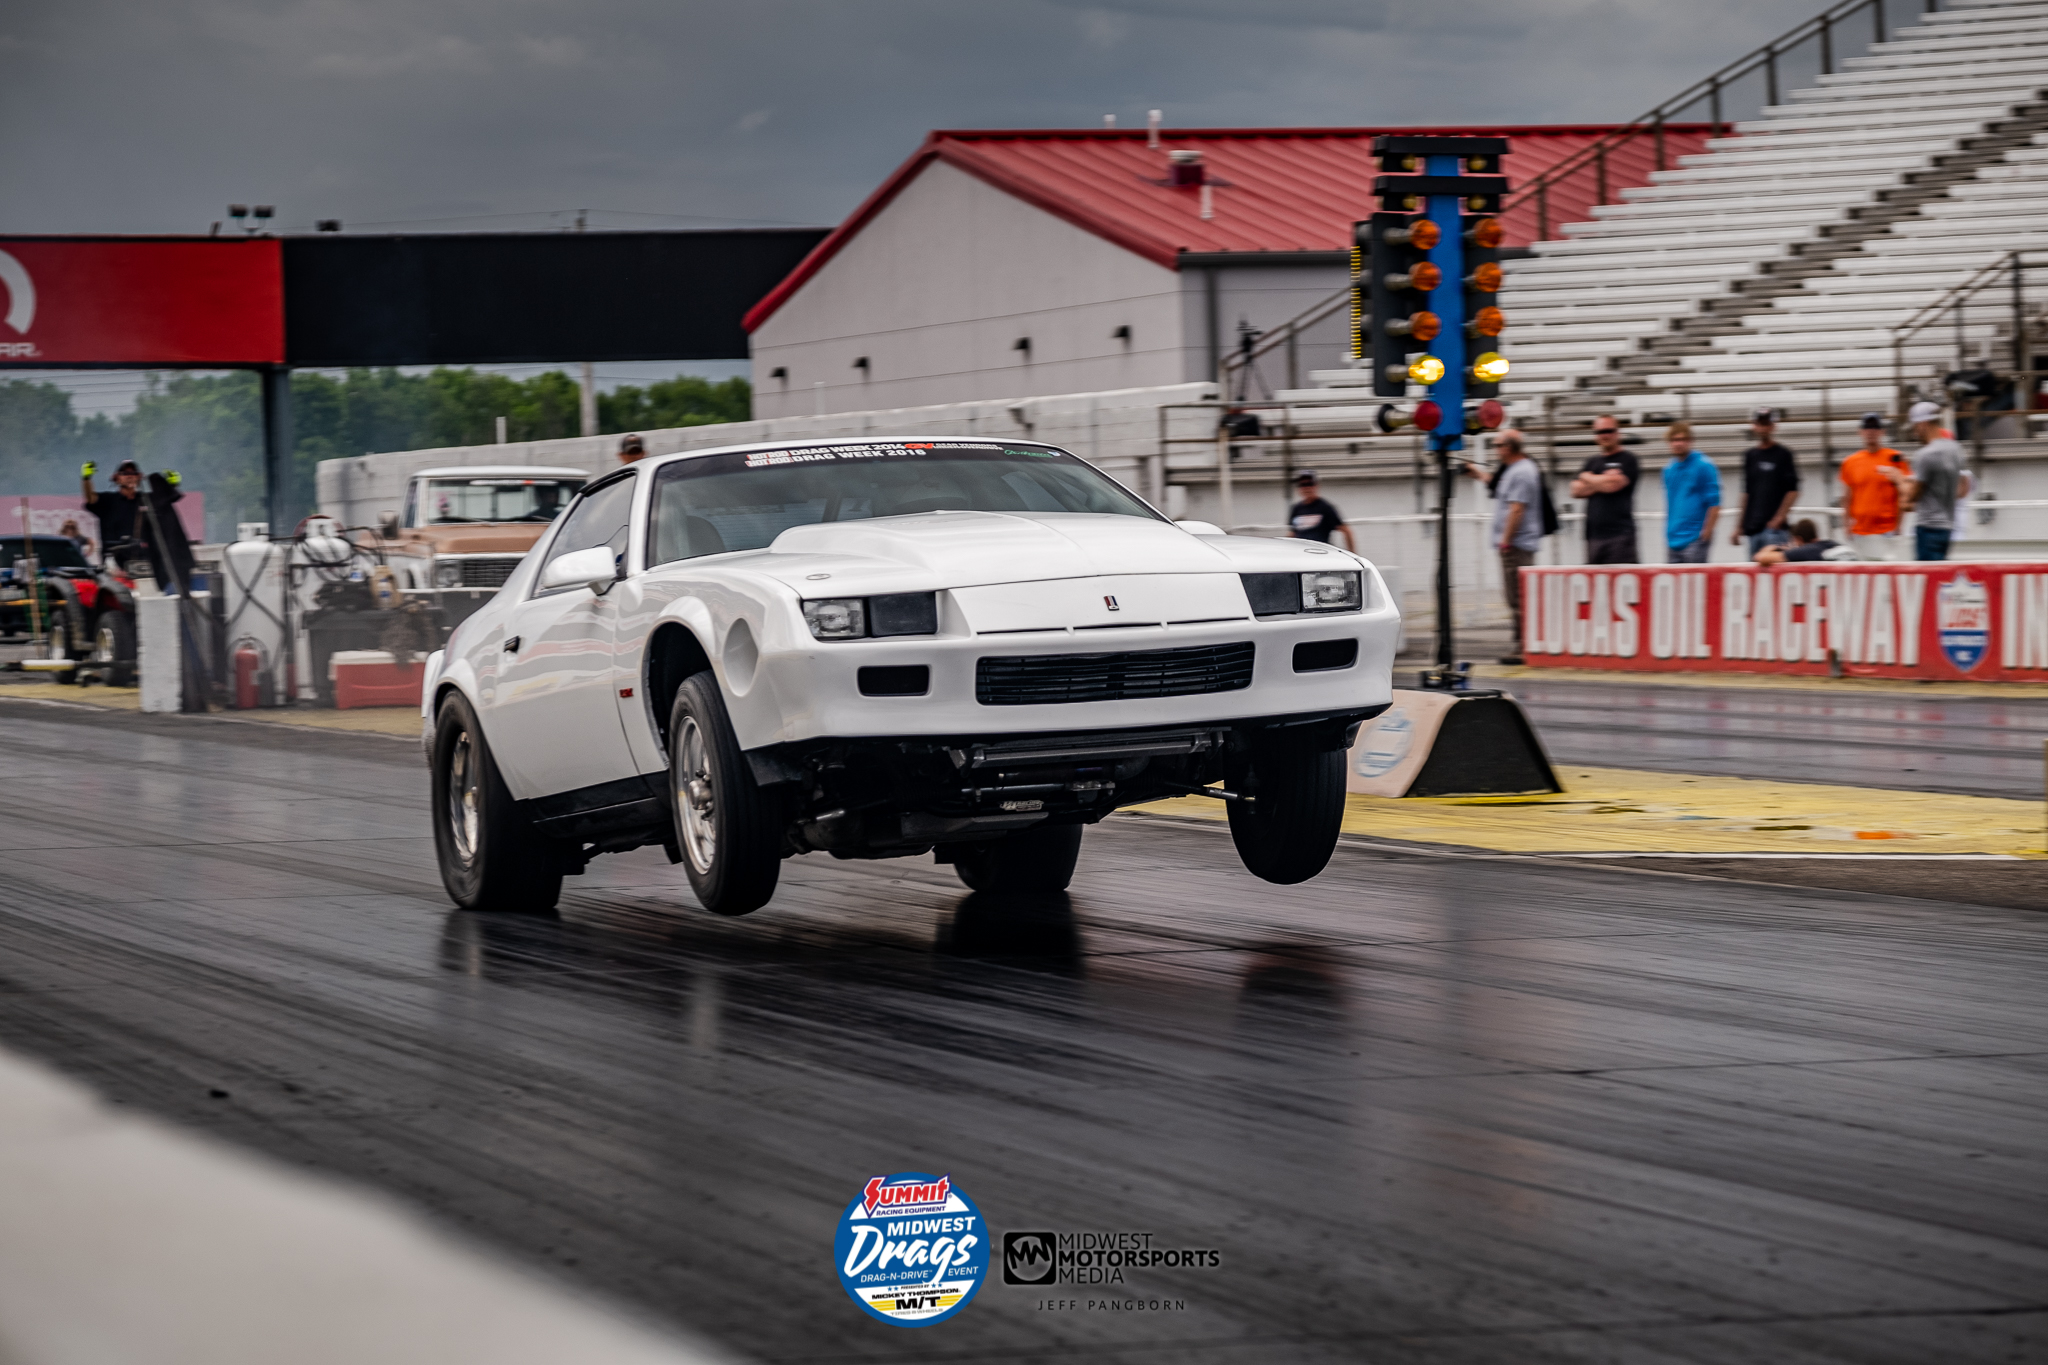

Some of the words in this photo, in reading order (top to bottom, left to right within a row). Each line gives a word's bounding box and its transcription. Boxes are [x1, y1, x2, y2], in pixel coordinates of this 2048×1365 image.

[788, 447, 830, 456] DRAG
[829, 444, 873, 453] WEEK
[872, 443, 906, 451] 2014
[791, 453, 836, 462] DRAG
[837, 450, 884, 459] WEEK
[886, 448, 927, 456] 2016
[1524, 572, 1641, 656] LUCAS
[1649, 572, 1712, 659] OIL
[1722, 572, 1928, 667] RACEWAY
